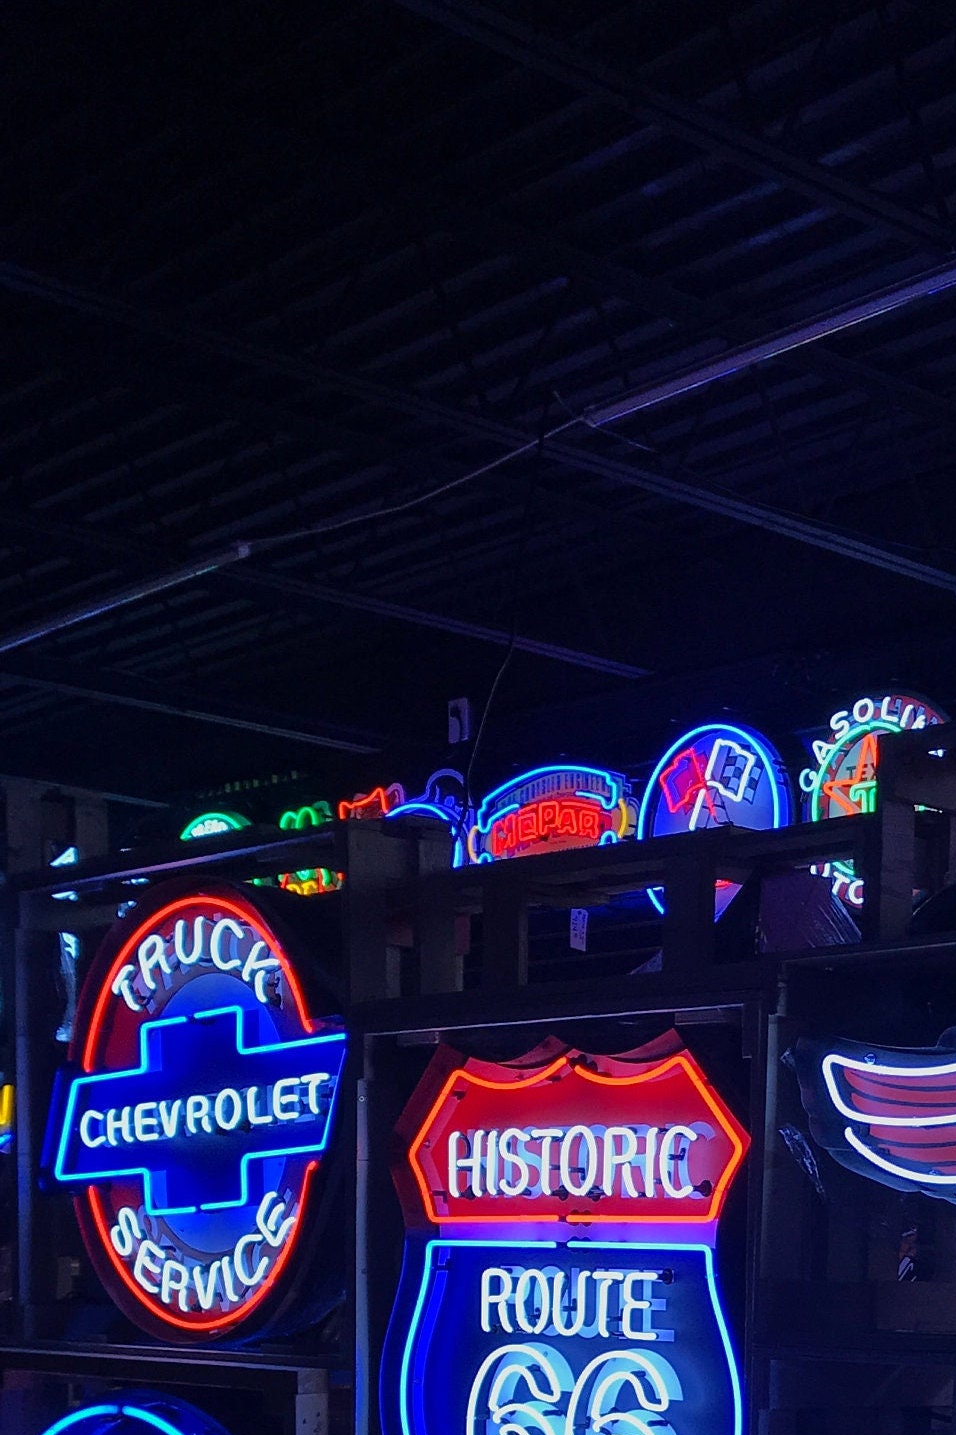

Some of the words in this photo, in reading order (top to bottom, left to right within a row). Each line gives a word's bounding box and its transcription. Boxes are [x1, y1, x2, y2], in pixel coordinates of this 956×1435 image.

[492, 801, 600, 856] MOPAR
[112, 916, 281, 1011] TRUCK
[80, 1072, 332, 1147] CHEVROLET
[448, 1125, 698, 1199] HISTORIC
[111, 1190, 296, 1312] SERVICE
[481, 1268, 659, 1340] ROUTE
